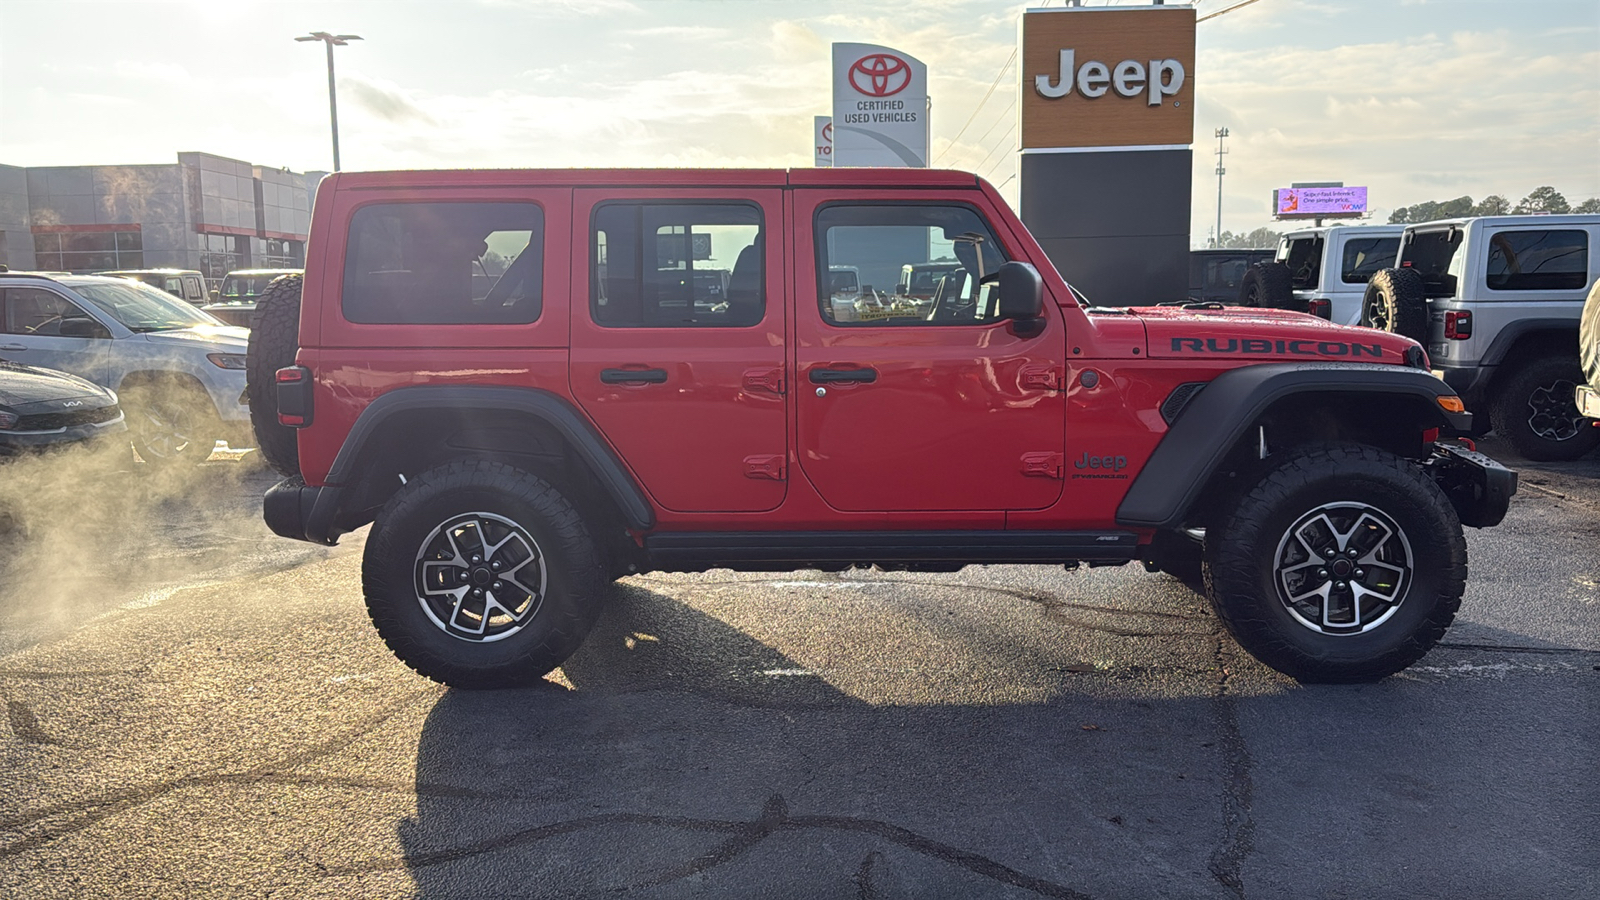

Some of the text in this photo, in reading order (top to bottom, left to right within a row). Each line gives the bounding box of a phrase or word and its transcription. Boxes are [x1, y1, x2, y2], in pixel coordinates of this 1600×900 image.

[1035, 48, 1185, 107] Jeep
[856, 100, 904, 111] CERTIFIED
[844, 112, 917, 124] USED VEHICLES
[816, 145, 832, 155] TO
[1171, 337, 1383, 358] RUBICON
[1074, 452, 1127, 472] Jeep
